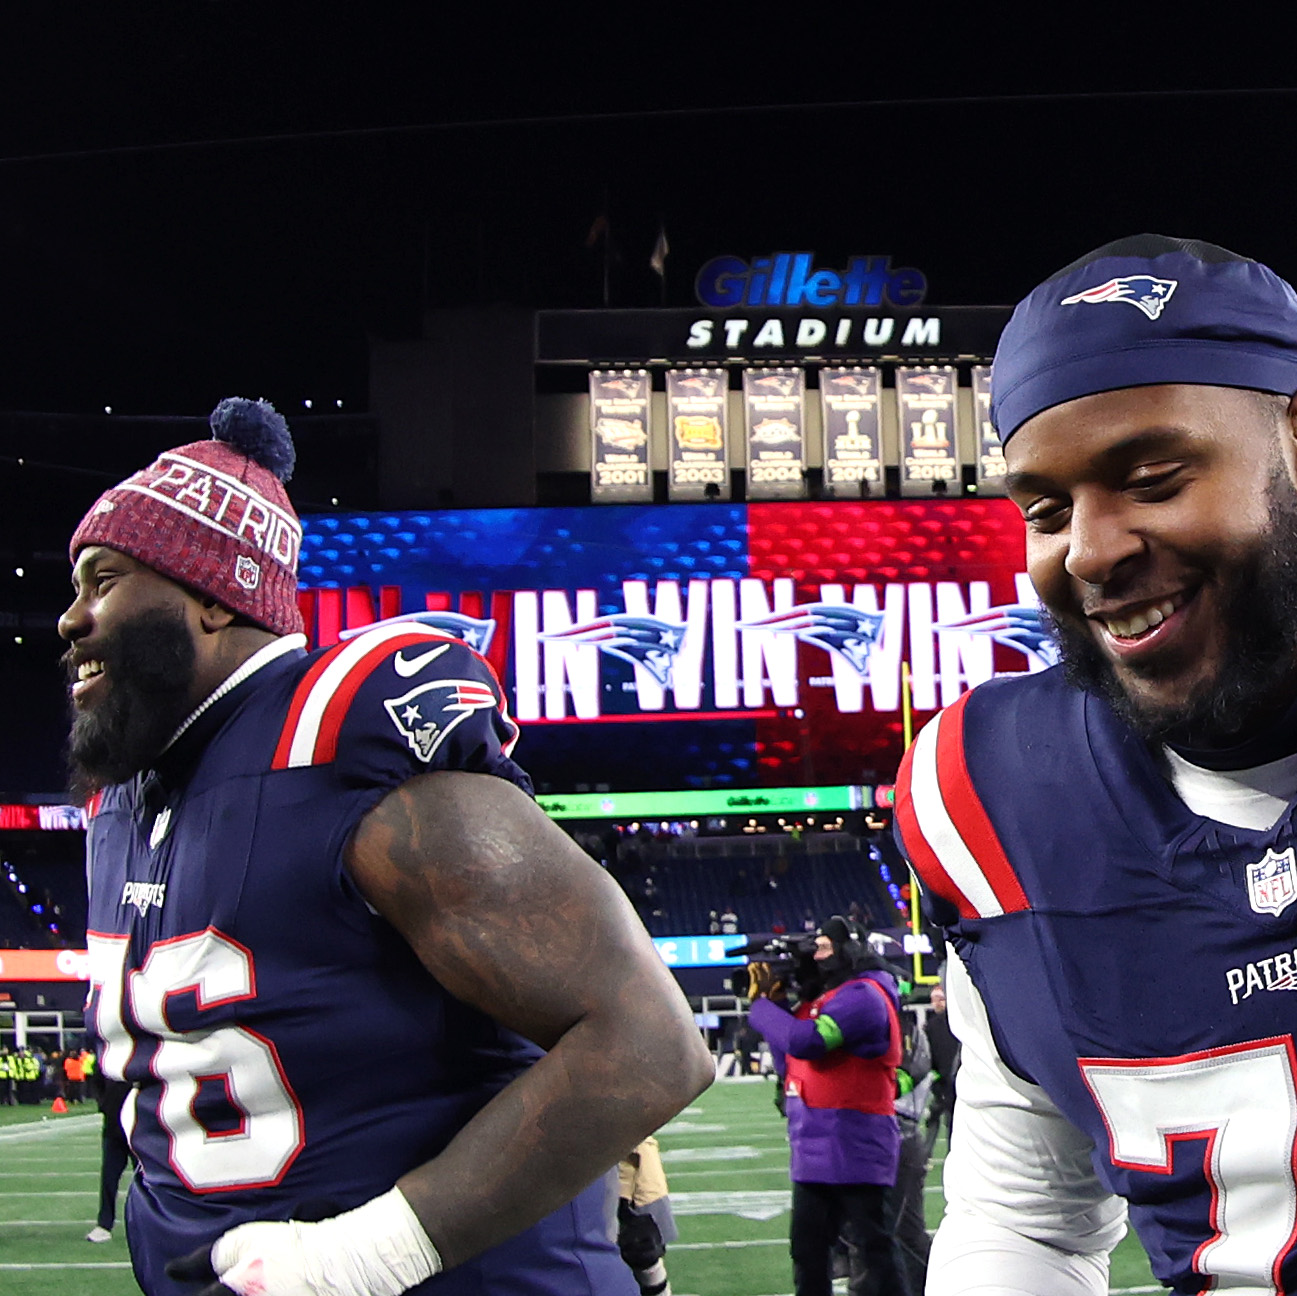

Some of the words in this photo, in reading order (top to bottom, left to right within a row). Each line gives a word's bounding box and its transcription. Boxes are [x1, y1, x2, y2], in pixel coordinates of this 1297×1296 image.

[695, 251, 928, 309] Gillette
[685, 316, 942, 349] STADIUM
[599, 470, 646, 485] 2001
[675, 468, 724, 483] 2003
[752, 467, 802, 482] 2004
[832, 467, 878, 482] 2014
[909, 465, 954, 479] 2016
[985, 463, 1007, 477] 20
[148, 462, 302, 575] PATRIOT
[1257, 875, 1292, 904] NFL
